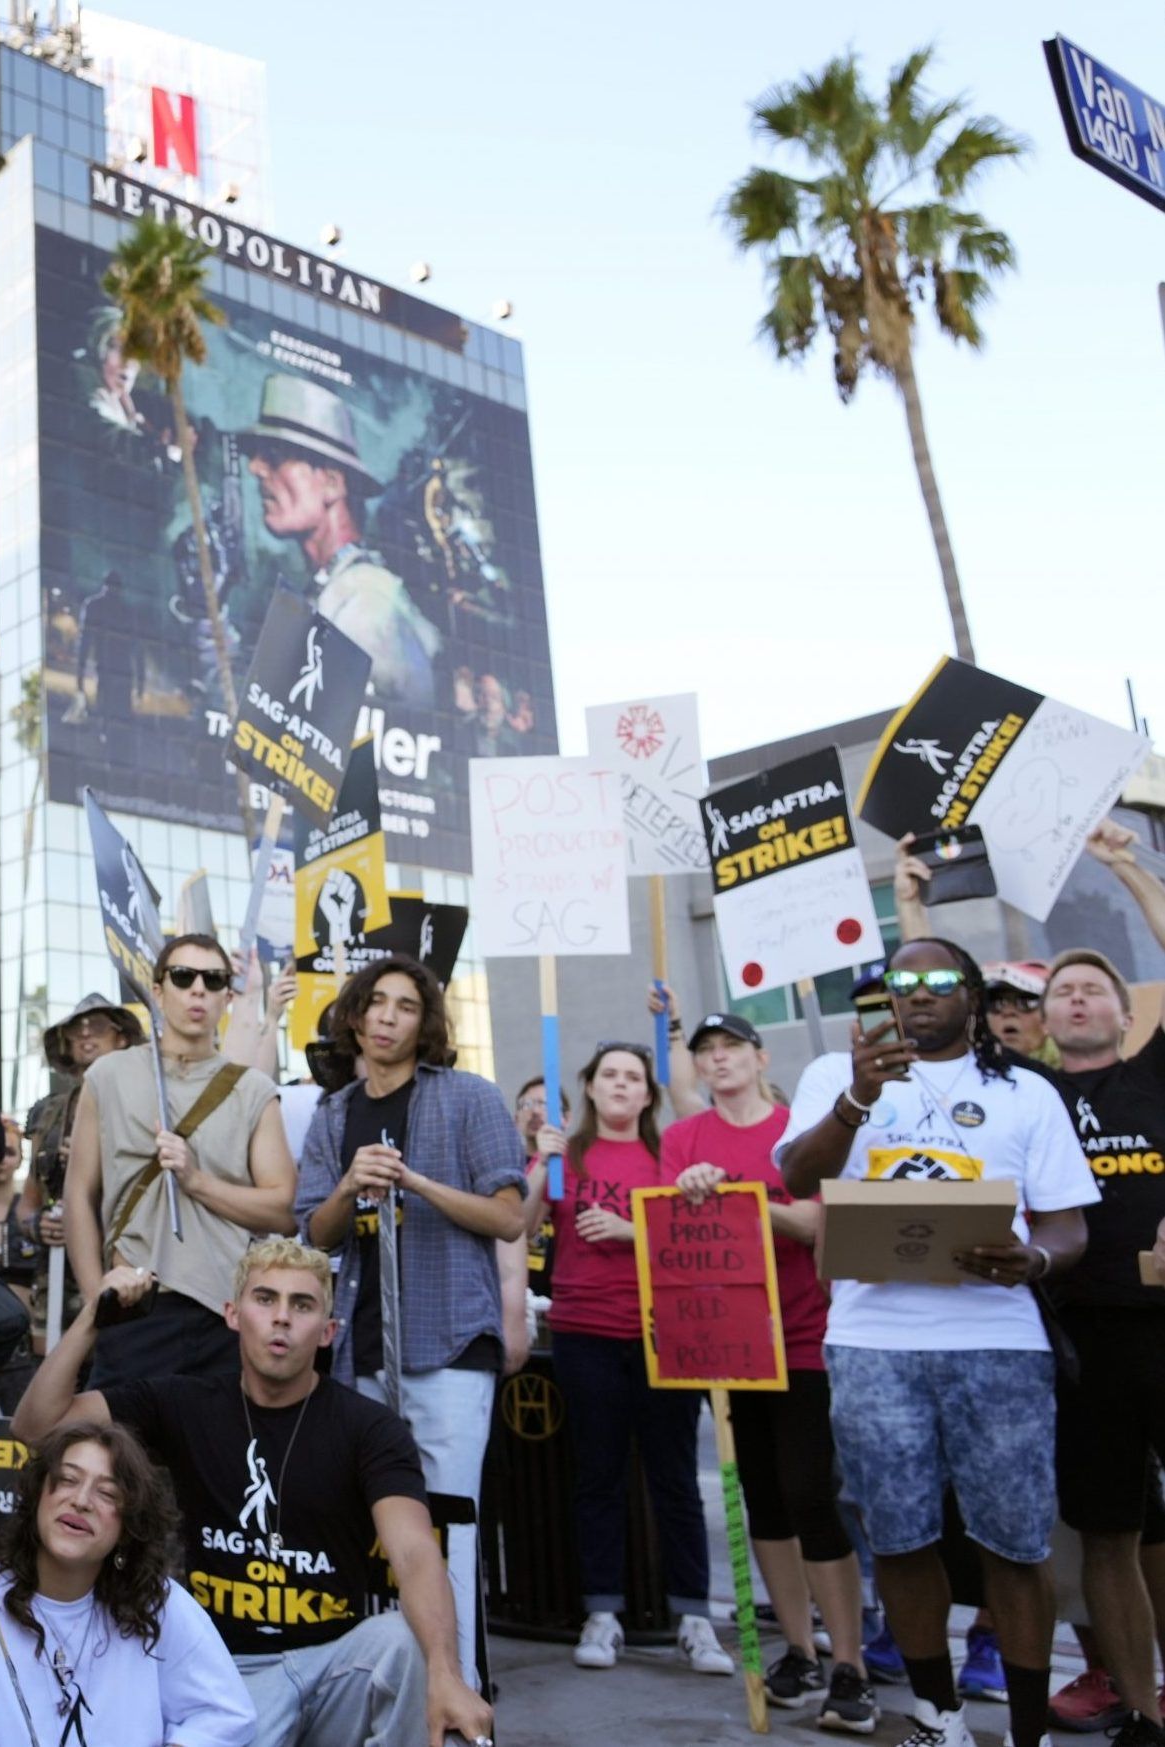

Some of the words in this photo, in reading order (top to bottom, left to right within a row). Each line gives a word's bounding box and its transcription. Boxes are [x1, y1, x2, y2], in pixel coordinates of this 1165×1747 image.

[1069, 48, 1136, 136] Van
[151, 86, 199, 177] N
[1081, 107, 1139, 171] 1400
[91, 170, 381, 314] METROPOLITAN
[234, 720, 335, 812] STRIKE!
[280, 734, 304, 757] ON
[961, 713, 1025, 808] STRIKE!
[484, 770, 613, 835] POST
[758, 818, 787, 841] ON
[304, 844, 321, 862] ON
[716, 815, 850, 888] STRIKE!
[505, 899, 602, 947] SAG
[576, 1180, 621, 1201] FIX
[658, 1248, 745, 1271] GUILD
[246, 1560, 286, 1584] ON
